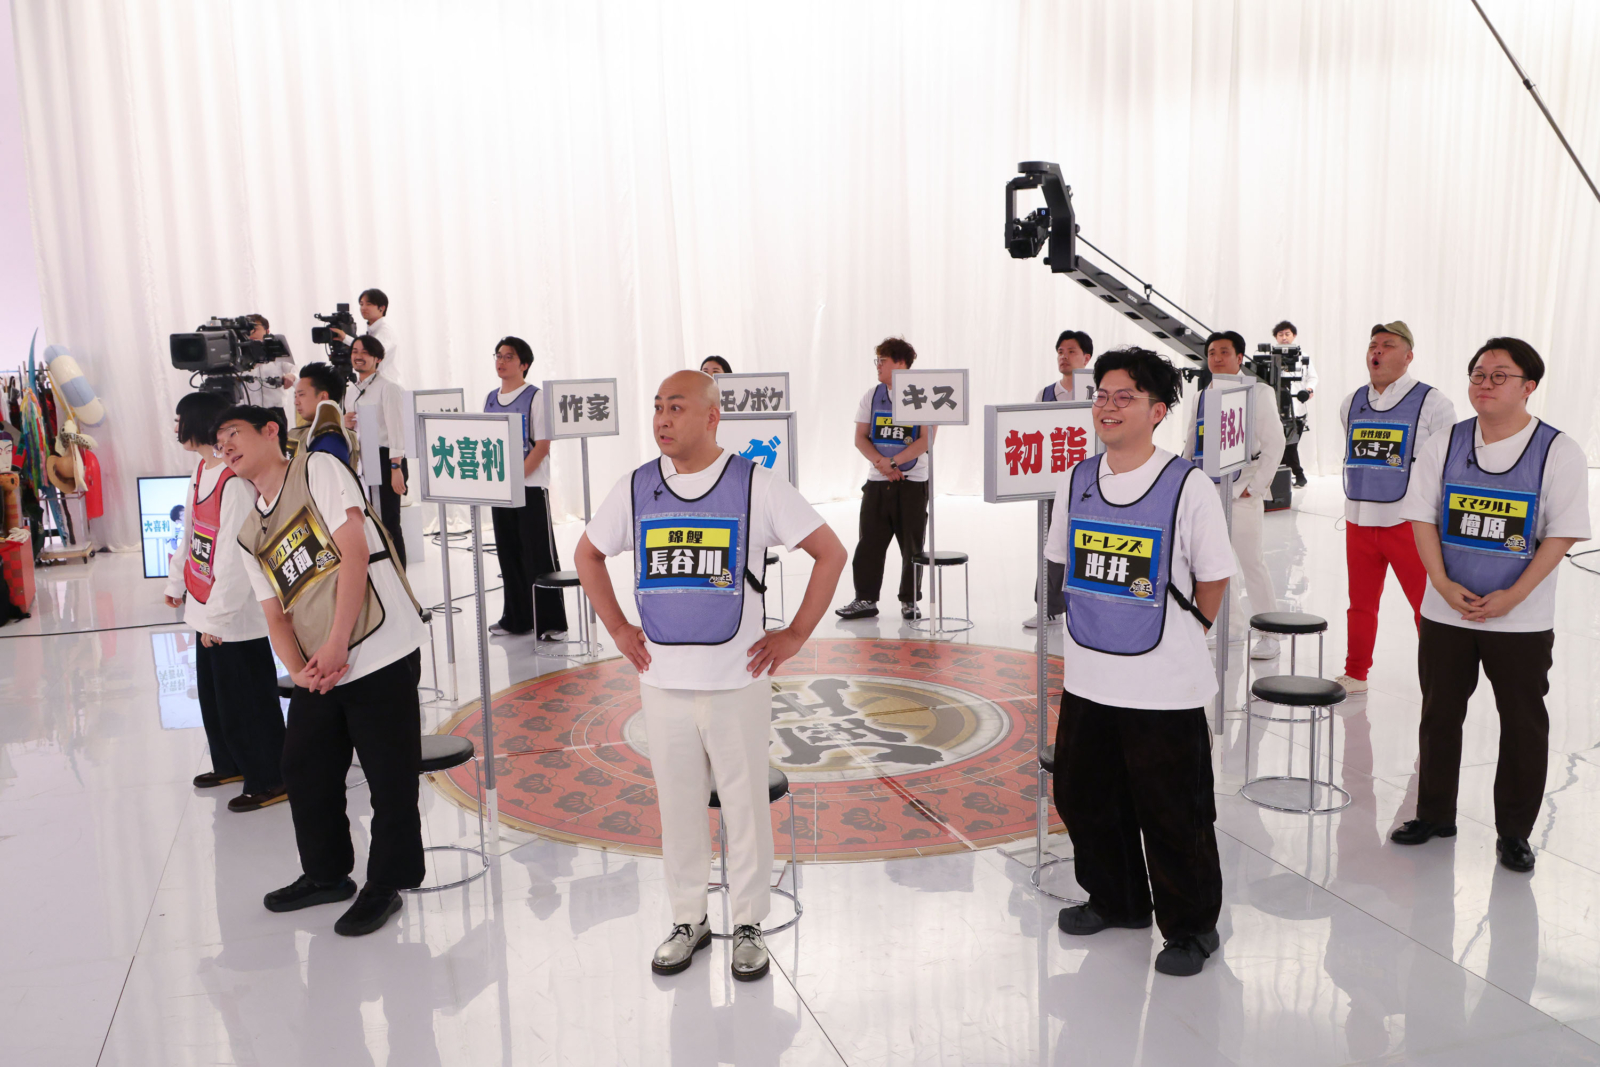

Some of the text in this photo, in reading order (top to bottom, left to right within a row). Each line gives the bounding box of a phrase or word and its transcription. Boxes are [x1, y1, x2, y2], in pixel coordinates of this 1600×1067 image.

[559, 393, 610, 423] 作家
[720, 386, 784, 411] モノボケ
[902, 384, 958, 410] キス
[880, 426, 904, 439] 中谷
[431, 436, 505, 482] 大喜利
[1005, 426, 1087, 476] 初詣
[1457, 496, 1518, 514] ママタルト
[144, 519, 171, 533] 大喜利
[668, 530, 703, 544] 錦鯉
[1459, 512, 1508, 539] 檜原
[1082, 532, 1143, 554] ヤーレンズ
[281, 545, 314, 587] 堂前
[649, 549, 723, 576] 長谷川
[1085, 552, 1130, 583] 出井
